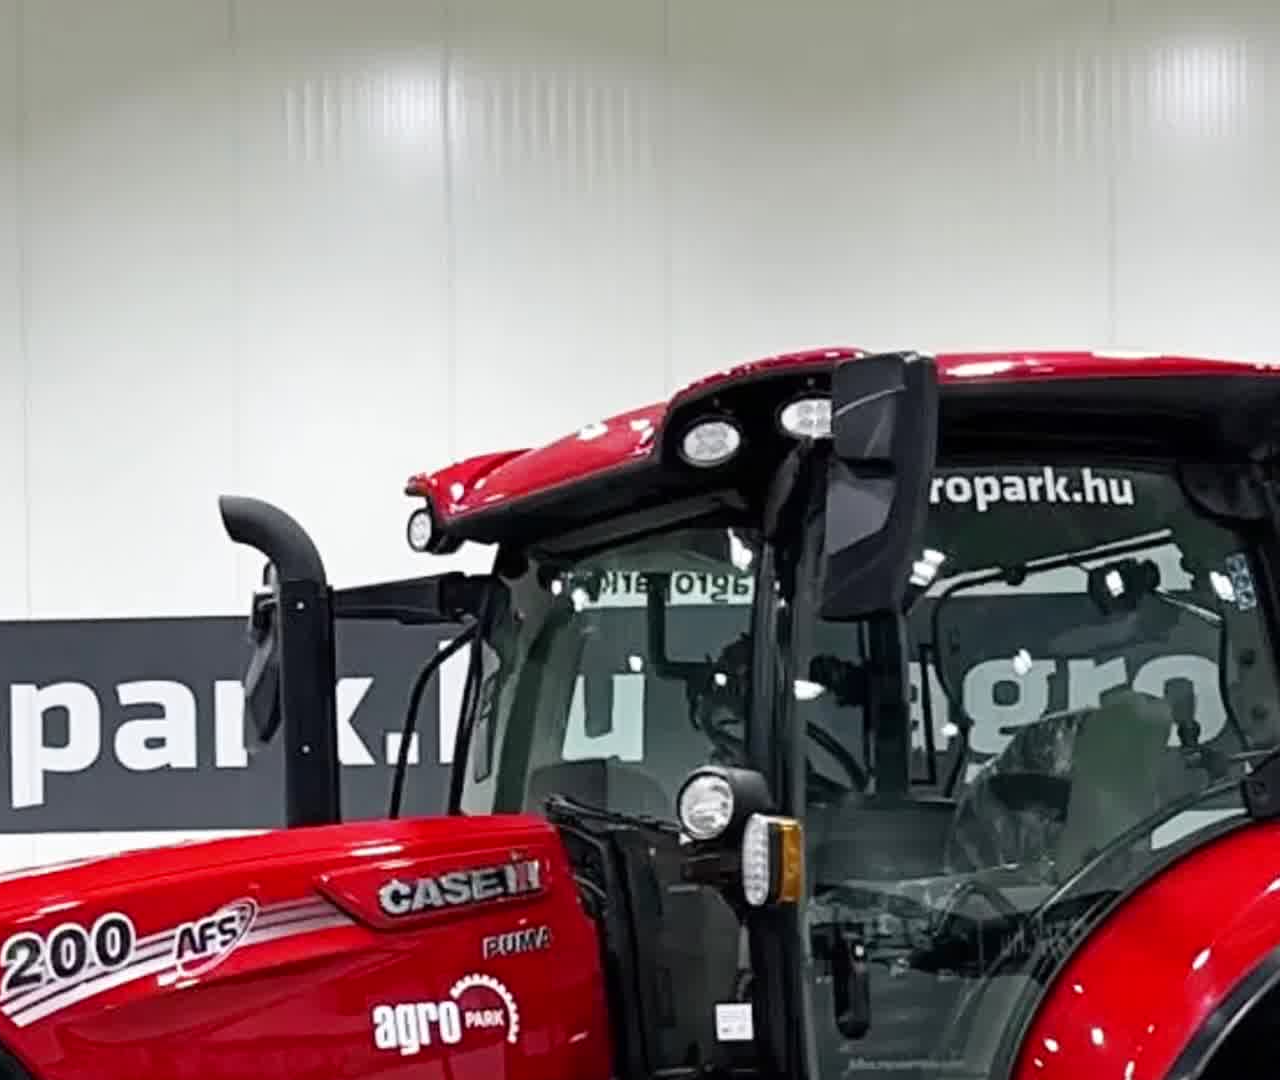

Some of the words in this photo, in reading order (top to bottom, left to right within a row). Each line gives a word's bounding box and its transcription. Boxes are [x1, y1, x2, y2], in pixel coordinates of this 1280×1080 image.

[929, 466, 1135, 512] ropark.hu
[378, 868, 505, 914] CASE
[2, 914, 134, 992] 200
[176, 914, 239, 960] AFS
[483, 925, 552, 960] PUMA
[373, 1001, 462, 1056] agro
[464, 1009, 505, 1028] PARK
